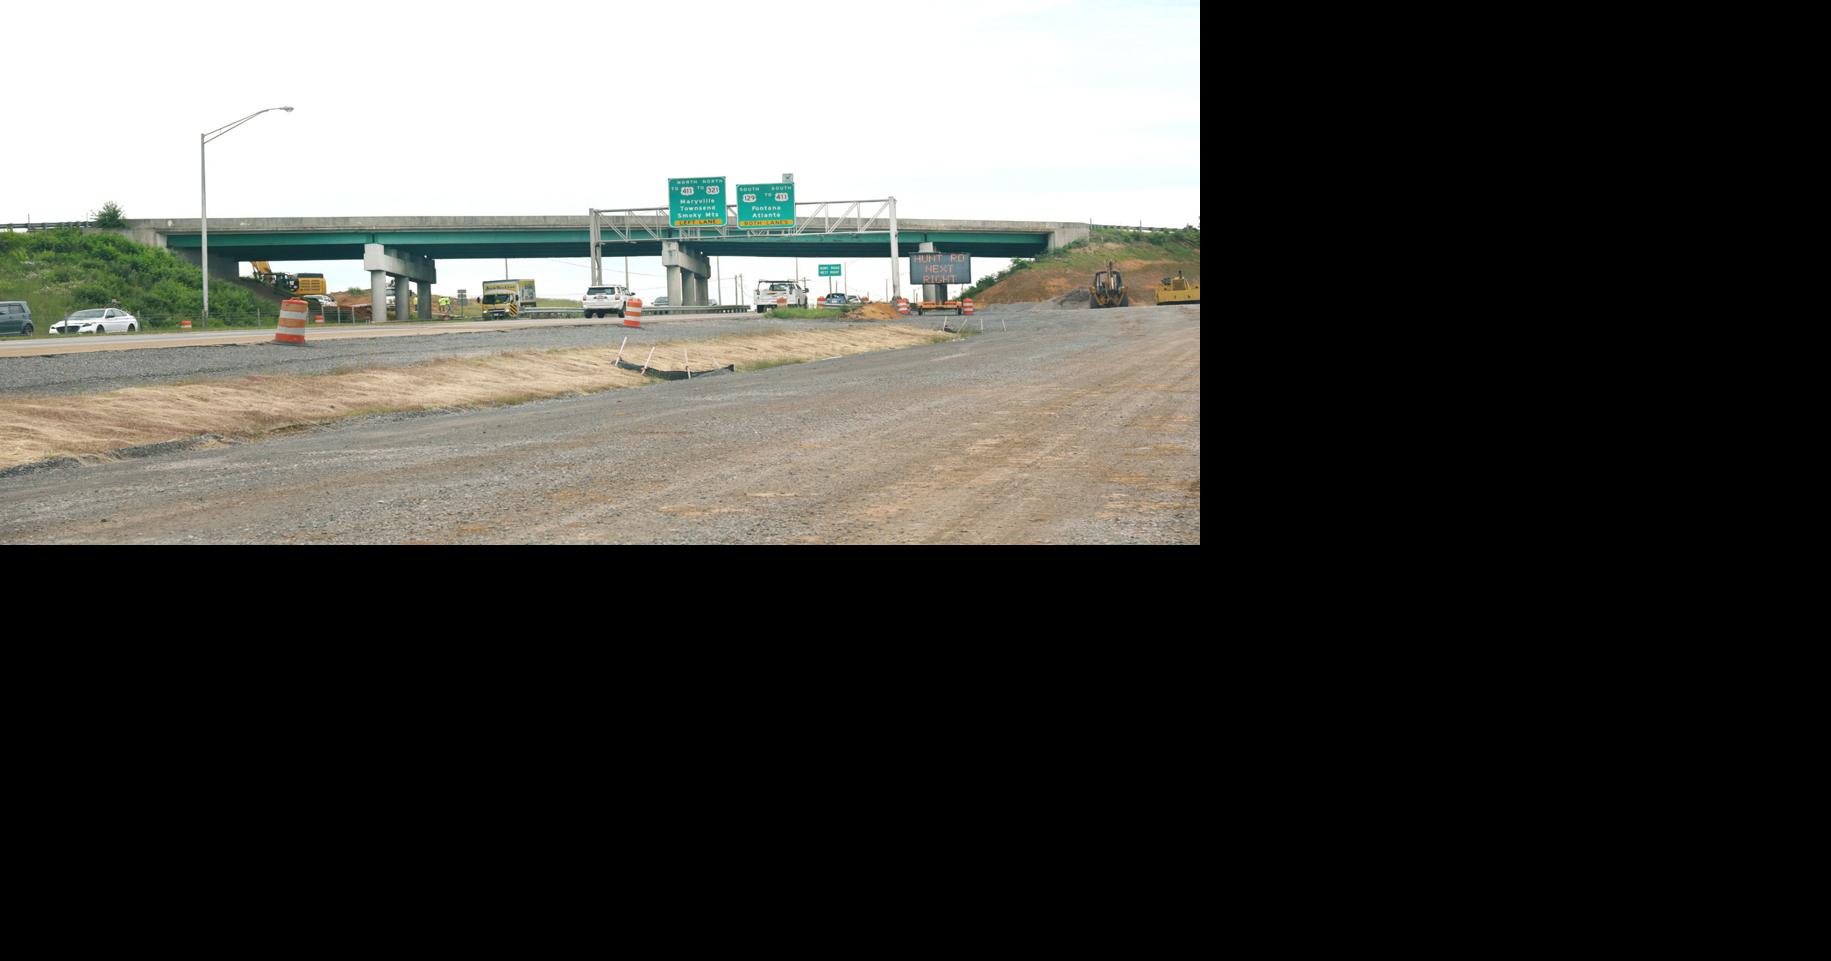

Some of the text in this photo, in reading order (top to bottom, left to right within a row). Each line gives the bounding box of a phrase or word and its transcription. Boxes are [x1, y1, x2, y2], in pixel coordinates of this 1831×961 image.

[914, 254, 944, 263] HUNT
[924, 264, 954, 273] NEXT
[923, 275, 957, 284] RIGHT
